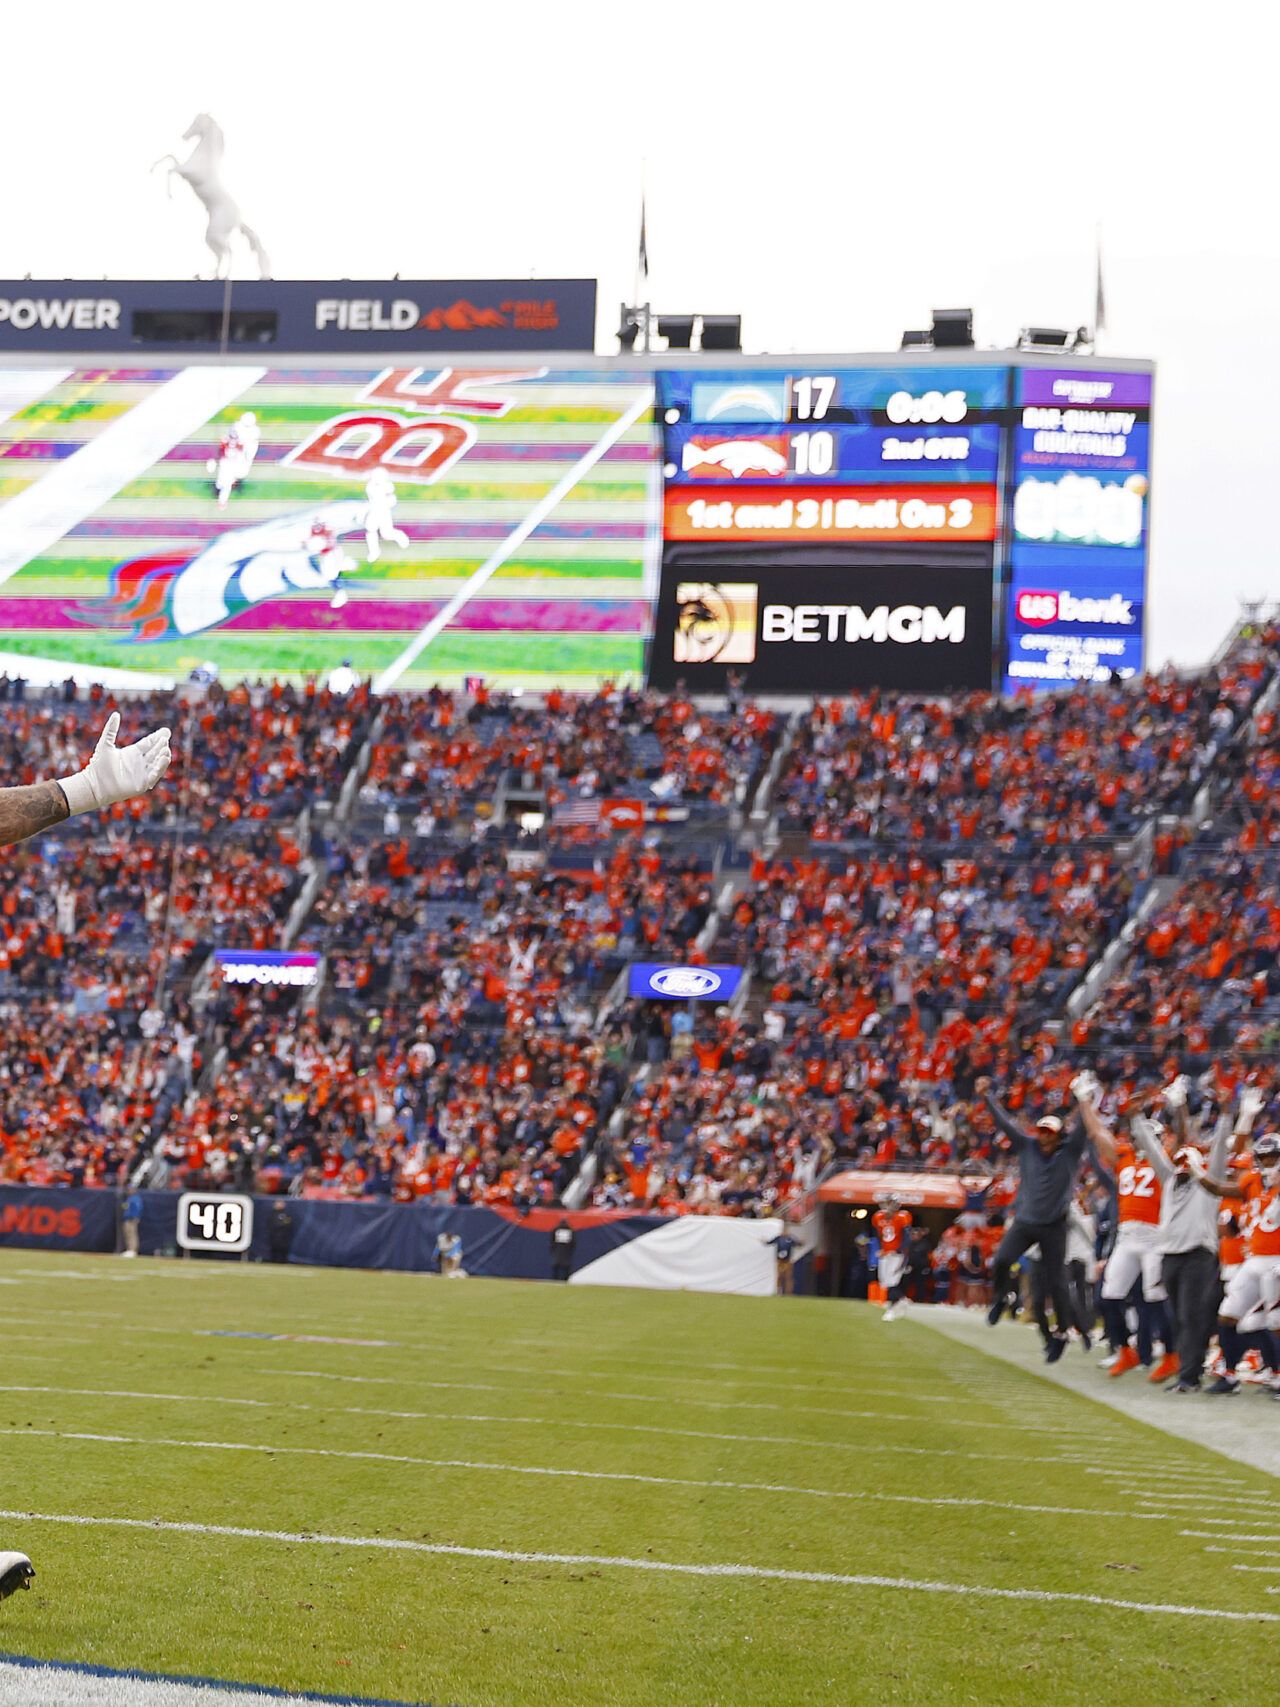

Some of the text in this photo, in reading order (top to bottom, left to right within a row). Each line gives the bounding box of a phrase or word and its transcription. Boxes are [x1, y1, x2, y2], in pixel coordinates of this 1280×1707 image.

[316, 300, 420, 330] FIELD
[793, 376, 836, 420] 17
[886, 391, 968, 423] 0:06
[791, 431, 834, 475] 10
[881, 438, 924, 460] 2nd
[687, 499, 973, 528] 1st and 3 Ball On 3
[762, 605, 965, 643] BETMGM
[1058, 591, 1135, 625] bank
[1118, 1165, 1156, 1198] 82
[189, 1203, 242, 1242] 40
